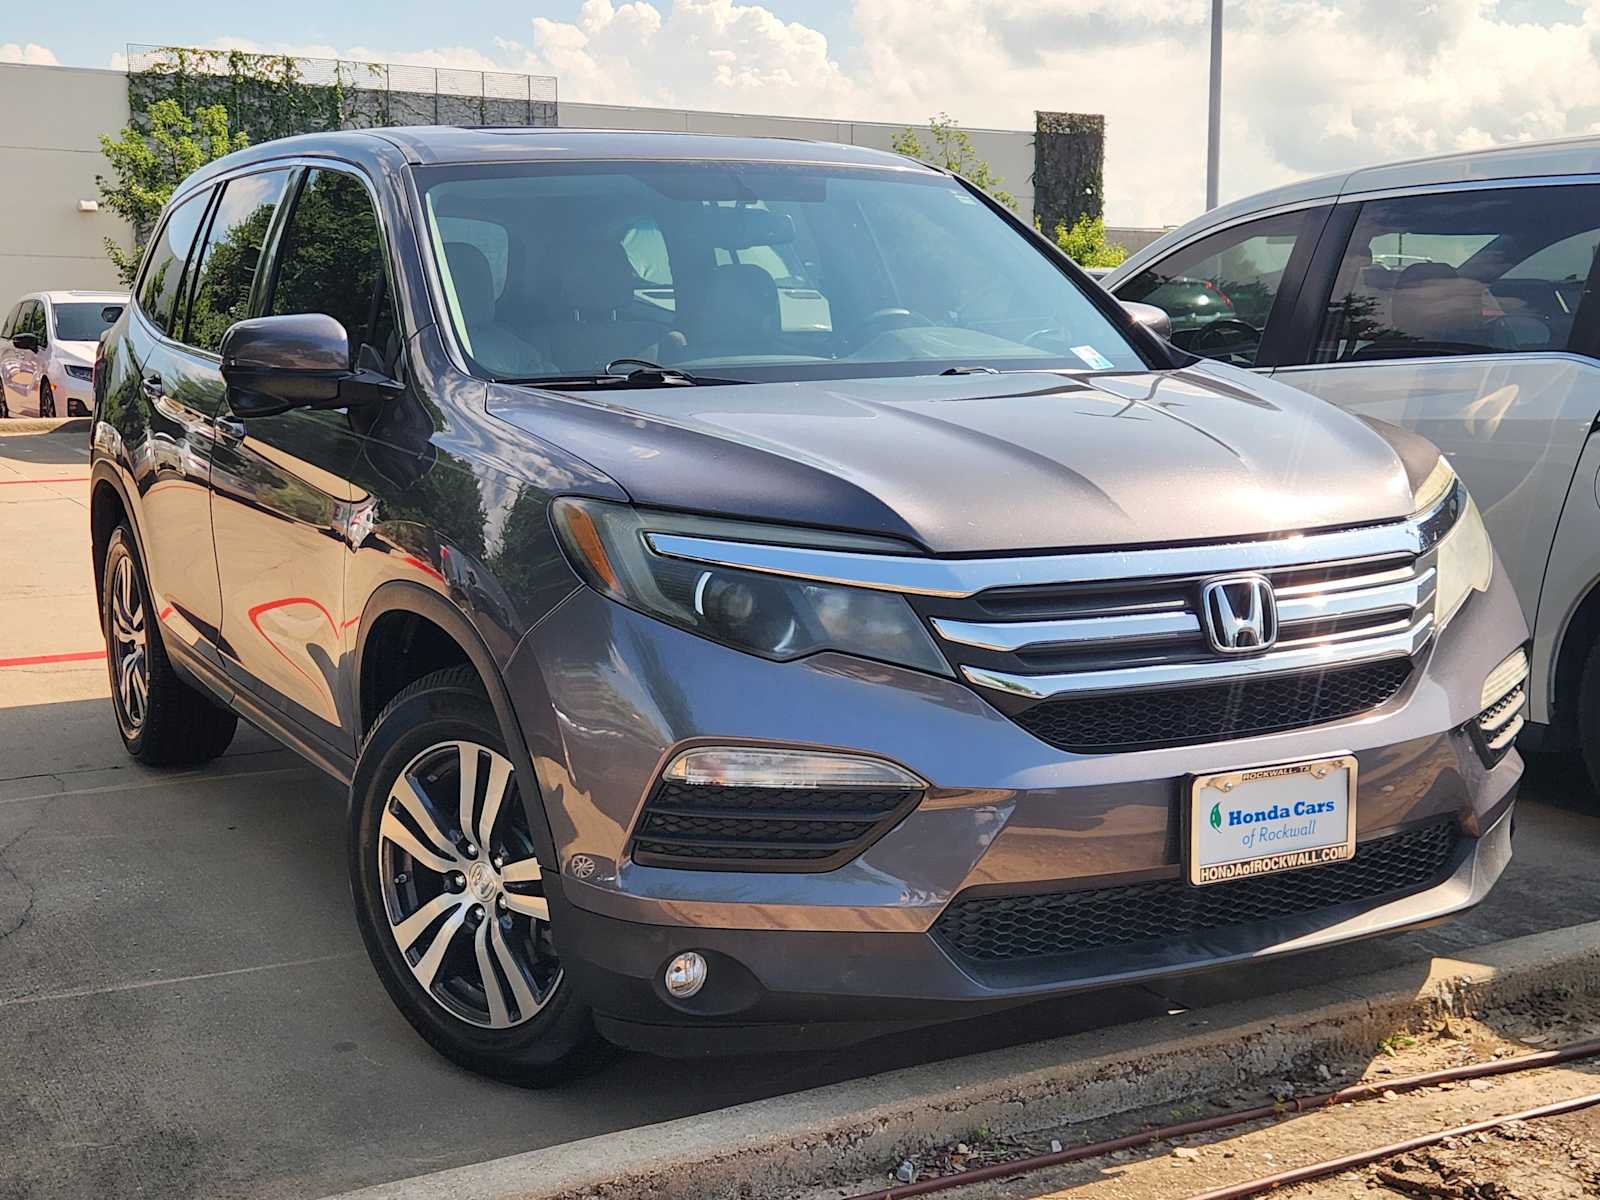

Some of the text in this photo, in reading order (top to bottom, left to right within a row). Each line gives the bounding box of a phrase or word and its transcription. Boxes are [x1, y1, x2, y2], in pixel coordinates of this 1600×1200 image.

[1228, 801, 1335, 826] Honda Cars
[1242, 820, 1316, 848] of Rockwall
[1201, 846, 1348, 882] HONDAofROCKWALL.COM
